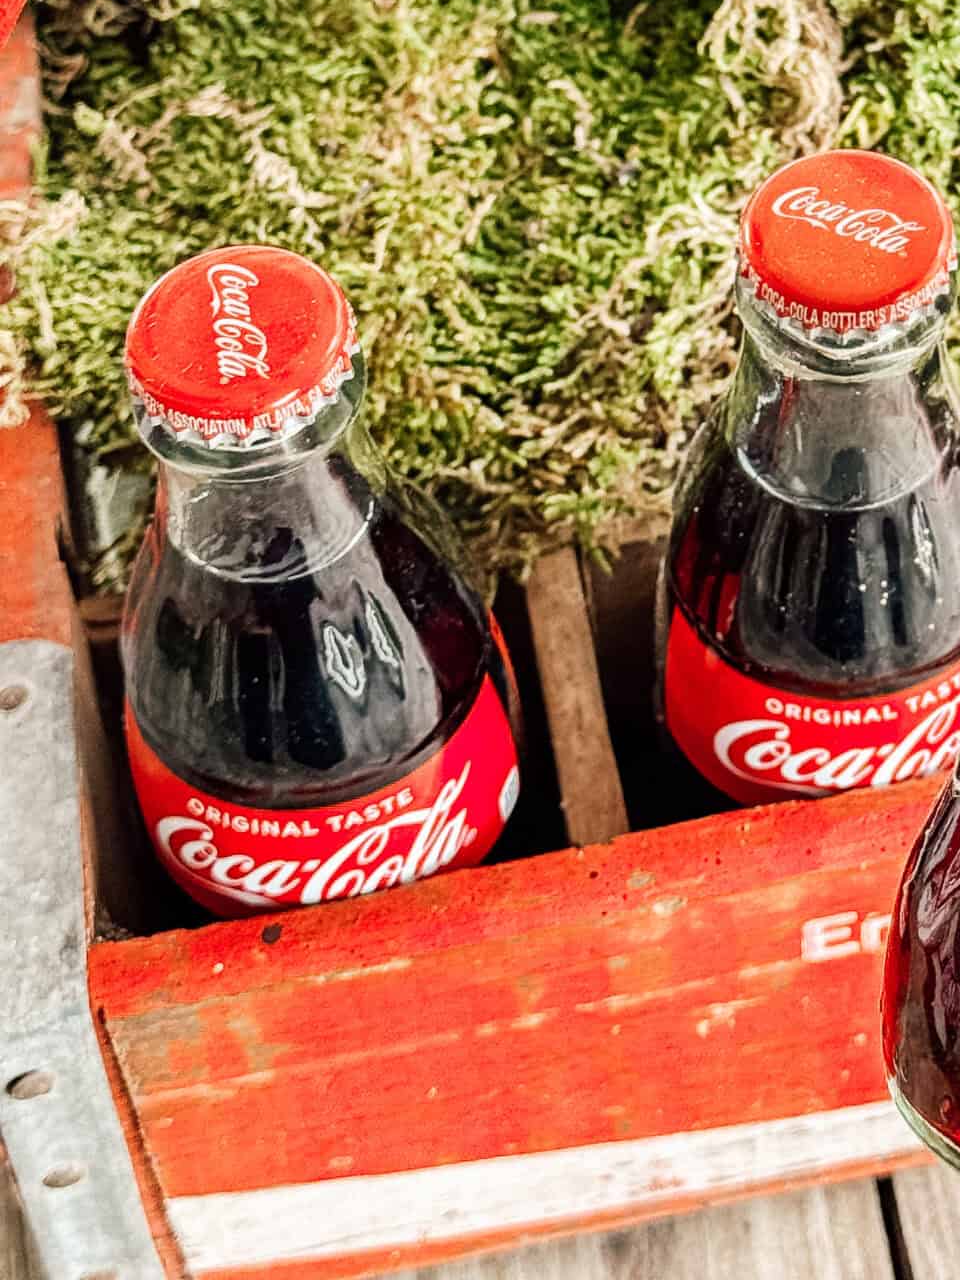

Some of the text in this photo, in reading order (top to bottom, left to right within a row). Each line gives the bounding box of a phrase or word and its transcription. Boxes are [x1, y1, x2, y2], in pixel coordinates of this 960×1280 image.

[771, 186, 928, 254] Coca-Cola
[207, 263, 271, 380] Coca-Cola
[822, 308, 887, 329] BOTTLER'S
[765, 697, 898, 726] ORIGINAL
[186, 787, 415, 838] ORIGINAL TASTE
